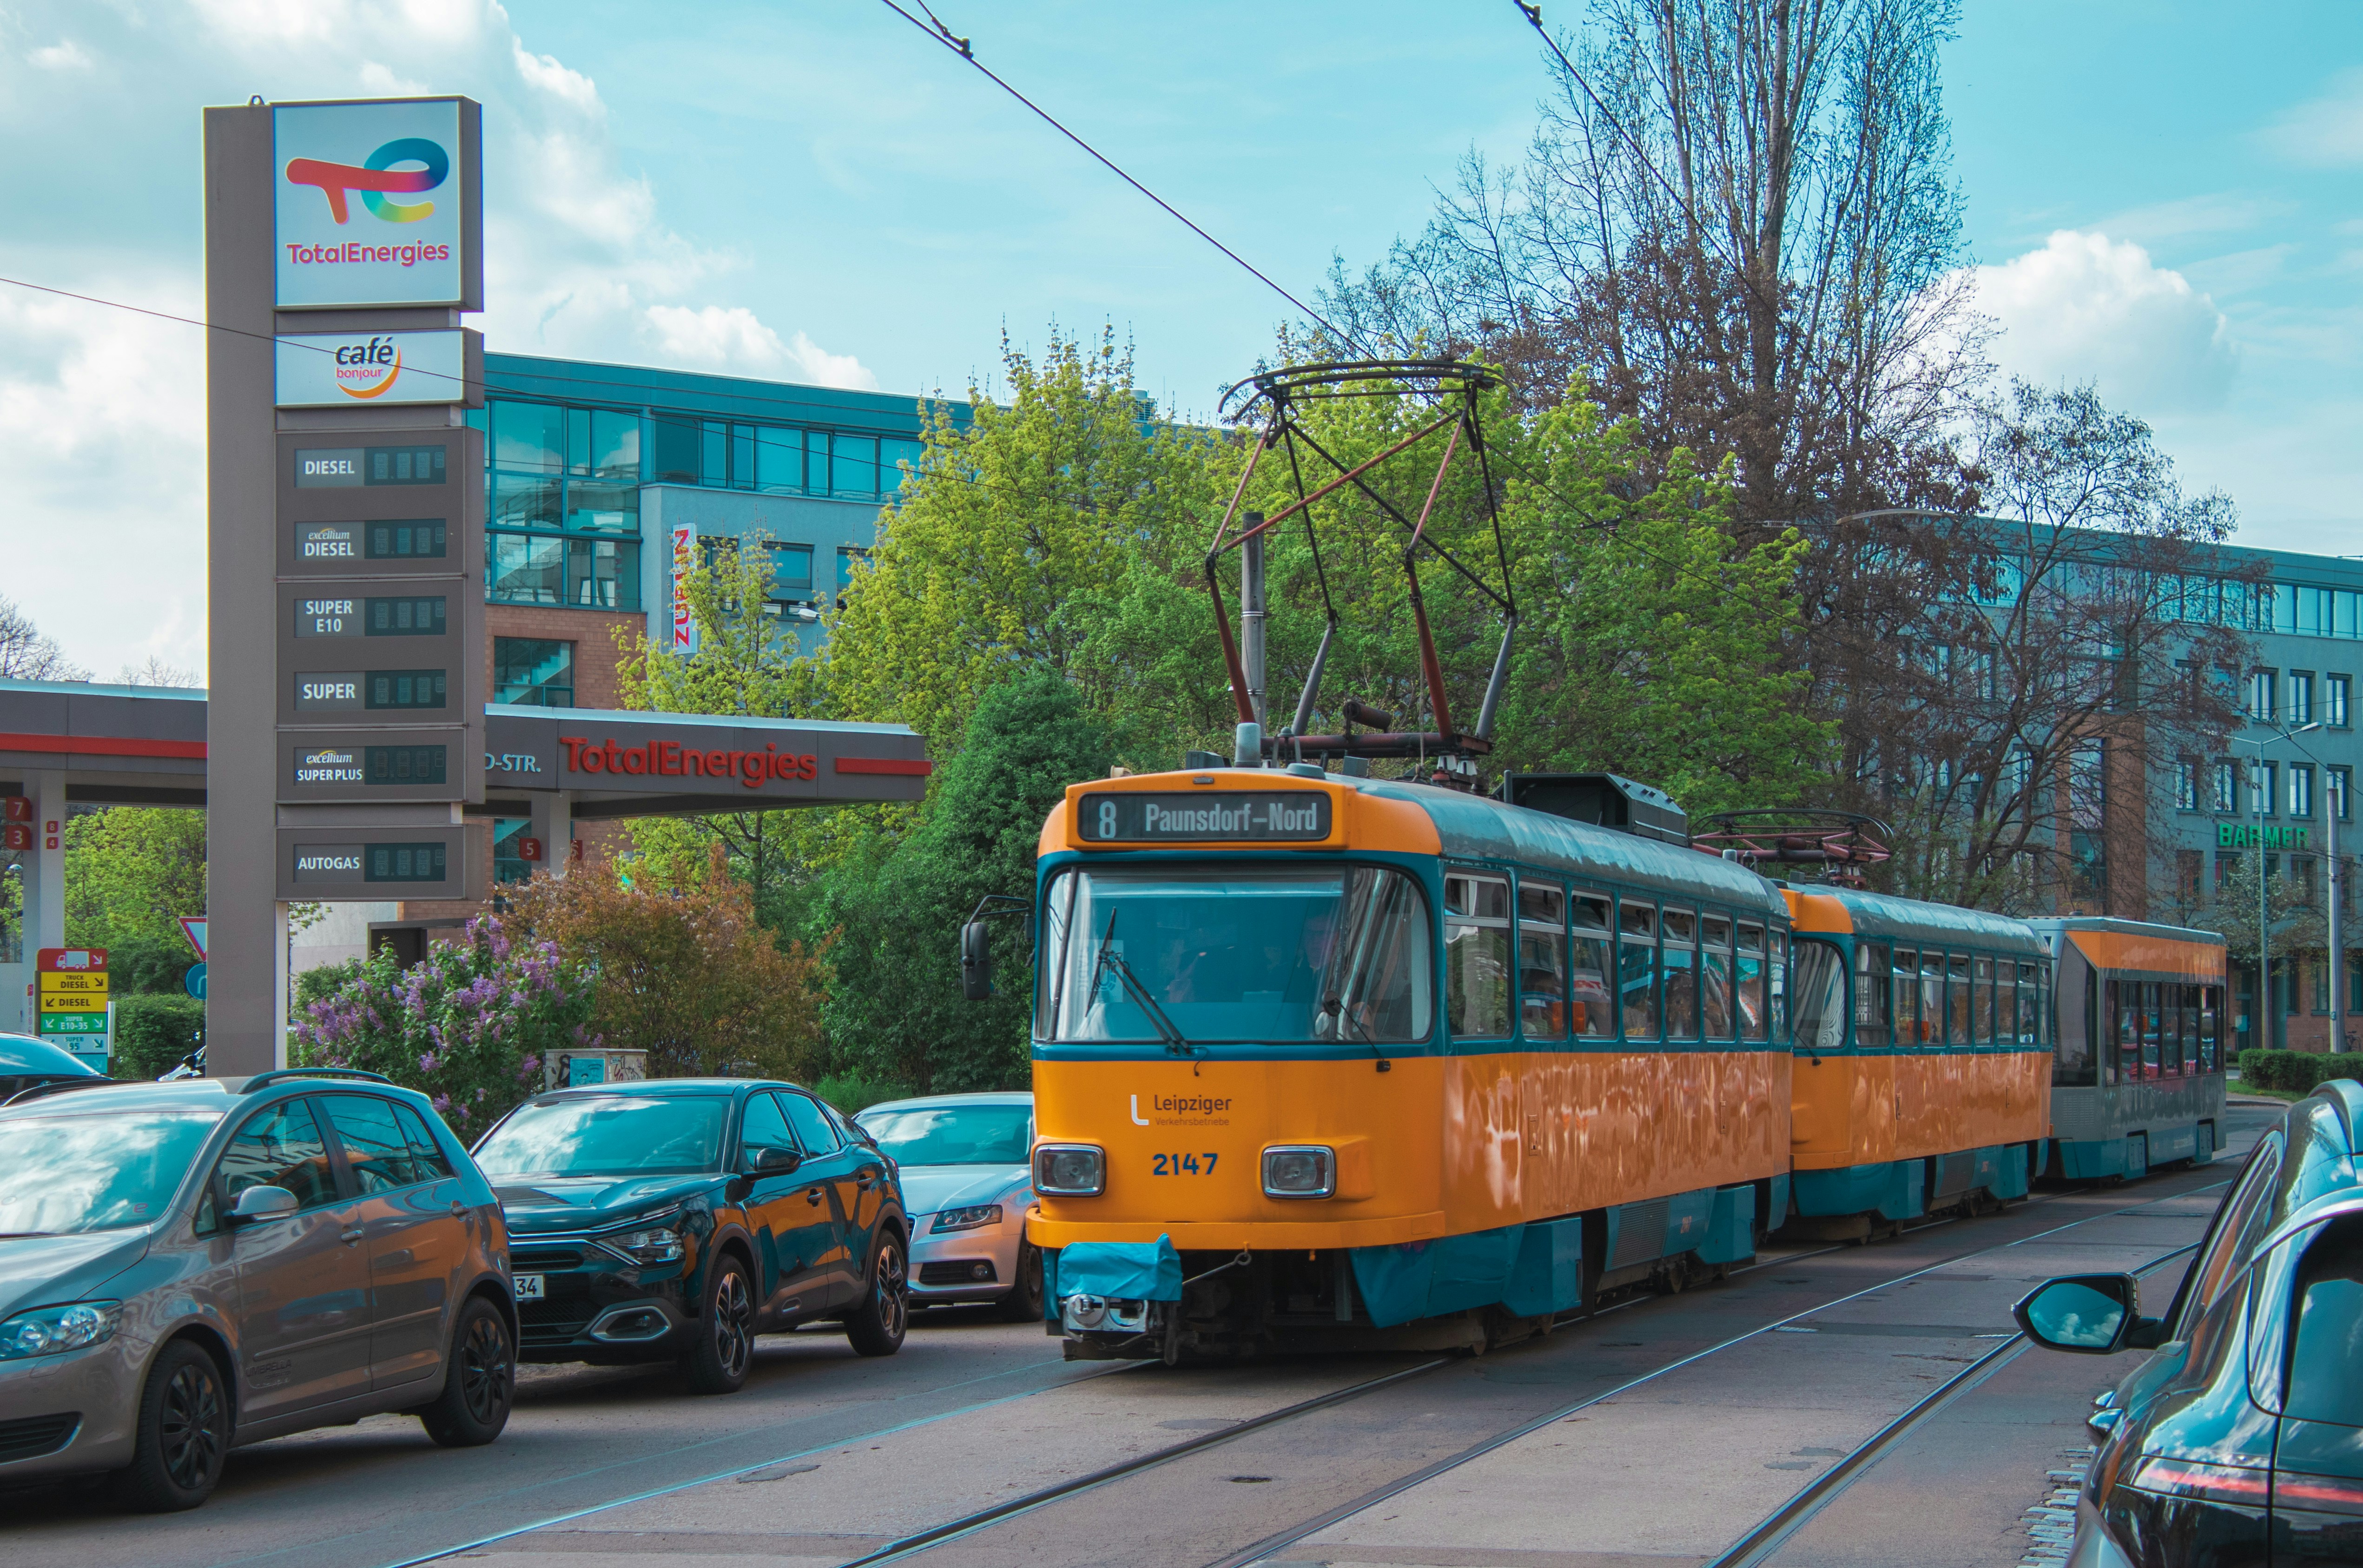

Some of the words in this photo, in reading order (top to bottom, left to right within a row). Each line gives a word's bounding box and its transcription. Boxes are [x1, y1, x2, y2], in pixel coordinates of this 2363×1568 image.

[286, 239, 449, 266] TotalEnergies
[335, 336, 393, 365] café
[336, 366, 383, 380] bonjour
[304, 460, 355, 474] DIESEL
[309, 530, 350, 540] excellium
[304, 542, 354, 556] DIESEL
[305, 600, 353, 615] SUPER
[316, 618, 342, 632] E10
[303, 683, 356, 699] SUPER
[306, 752, 352, 764] excellium
[561, 736, 817, 787] TotalEnergies
[297, 769, 333, 781] SUPER
[335, 769, 363, 781] PLUS
[14, 802, 23, 816] 7
[1099, 801, 1116, 838] 8
[1146, 803, 1317, 832] Paunsdorf-Nord
[14, 830, 23, 844] 3
[2219, 824, 2310, 849] BARMER
[527, 843, 534, 856] 5
[297, 857, 360, 870] AUTOGAS
[1154, 1094, 1232, 1115] Leipziger
[1155, 1117, 1229, 1126] Verkehrsbetriebe
[1153, 1153, 1218, 1176] 2147
[516, 1278, 537, 1296] 34
